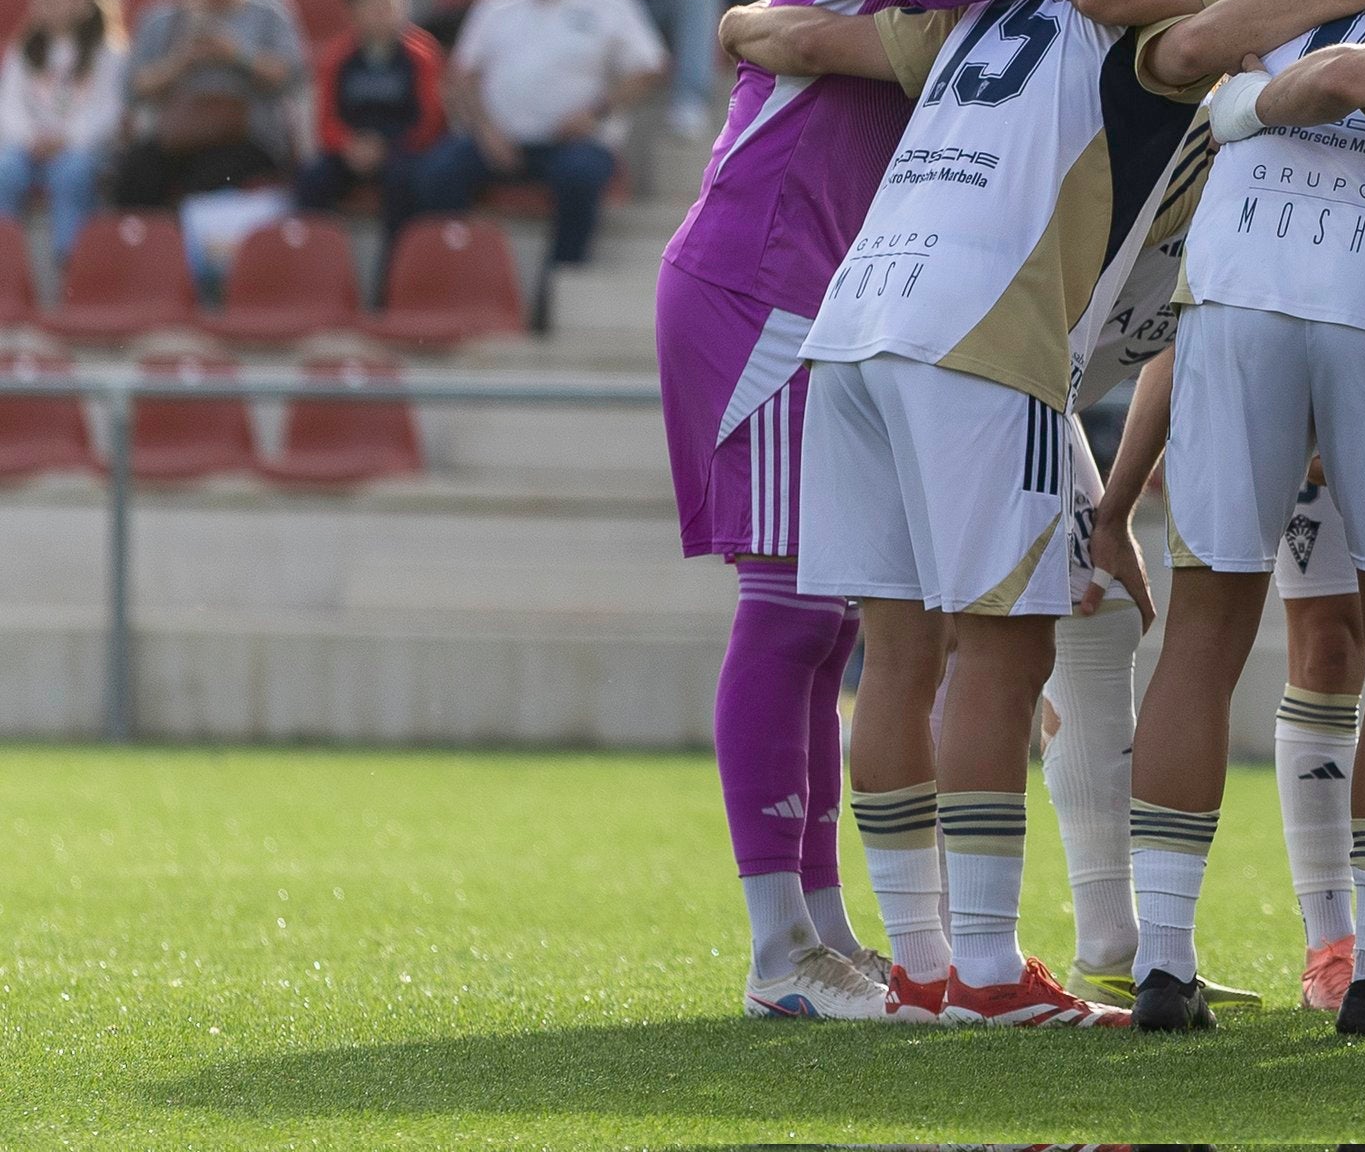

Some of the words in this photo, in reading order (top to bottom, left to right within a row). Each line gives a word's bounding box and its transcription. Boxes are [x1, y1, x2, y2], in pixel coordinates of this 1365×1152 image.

[1253, 125, 1286, 137] ntro
[1289, 126, 1348, 149] Porsche
[937, 167, 989, 189] Marbella
[857, 233, 939, 251] GRUPO
[829, 261, 924, 300] MOSH
[1105, 304, 1177, 342] ARB
